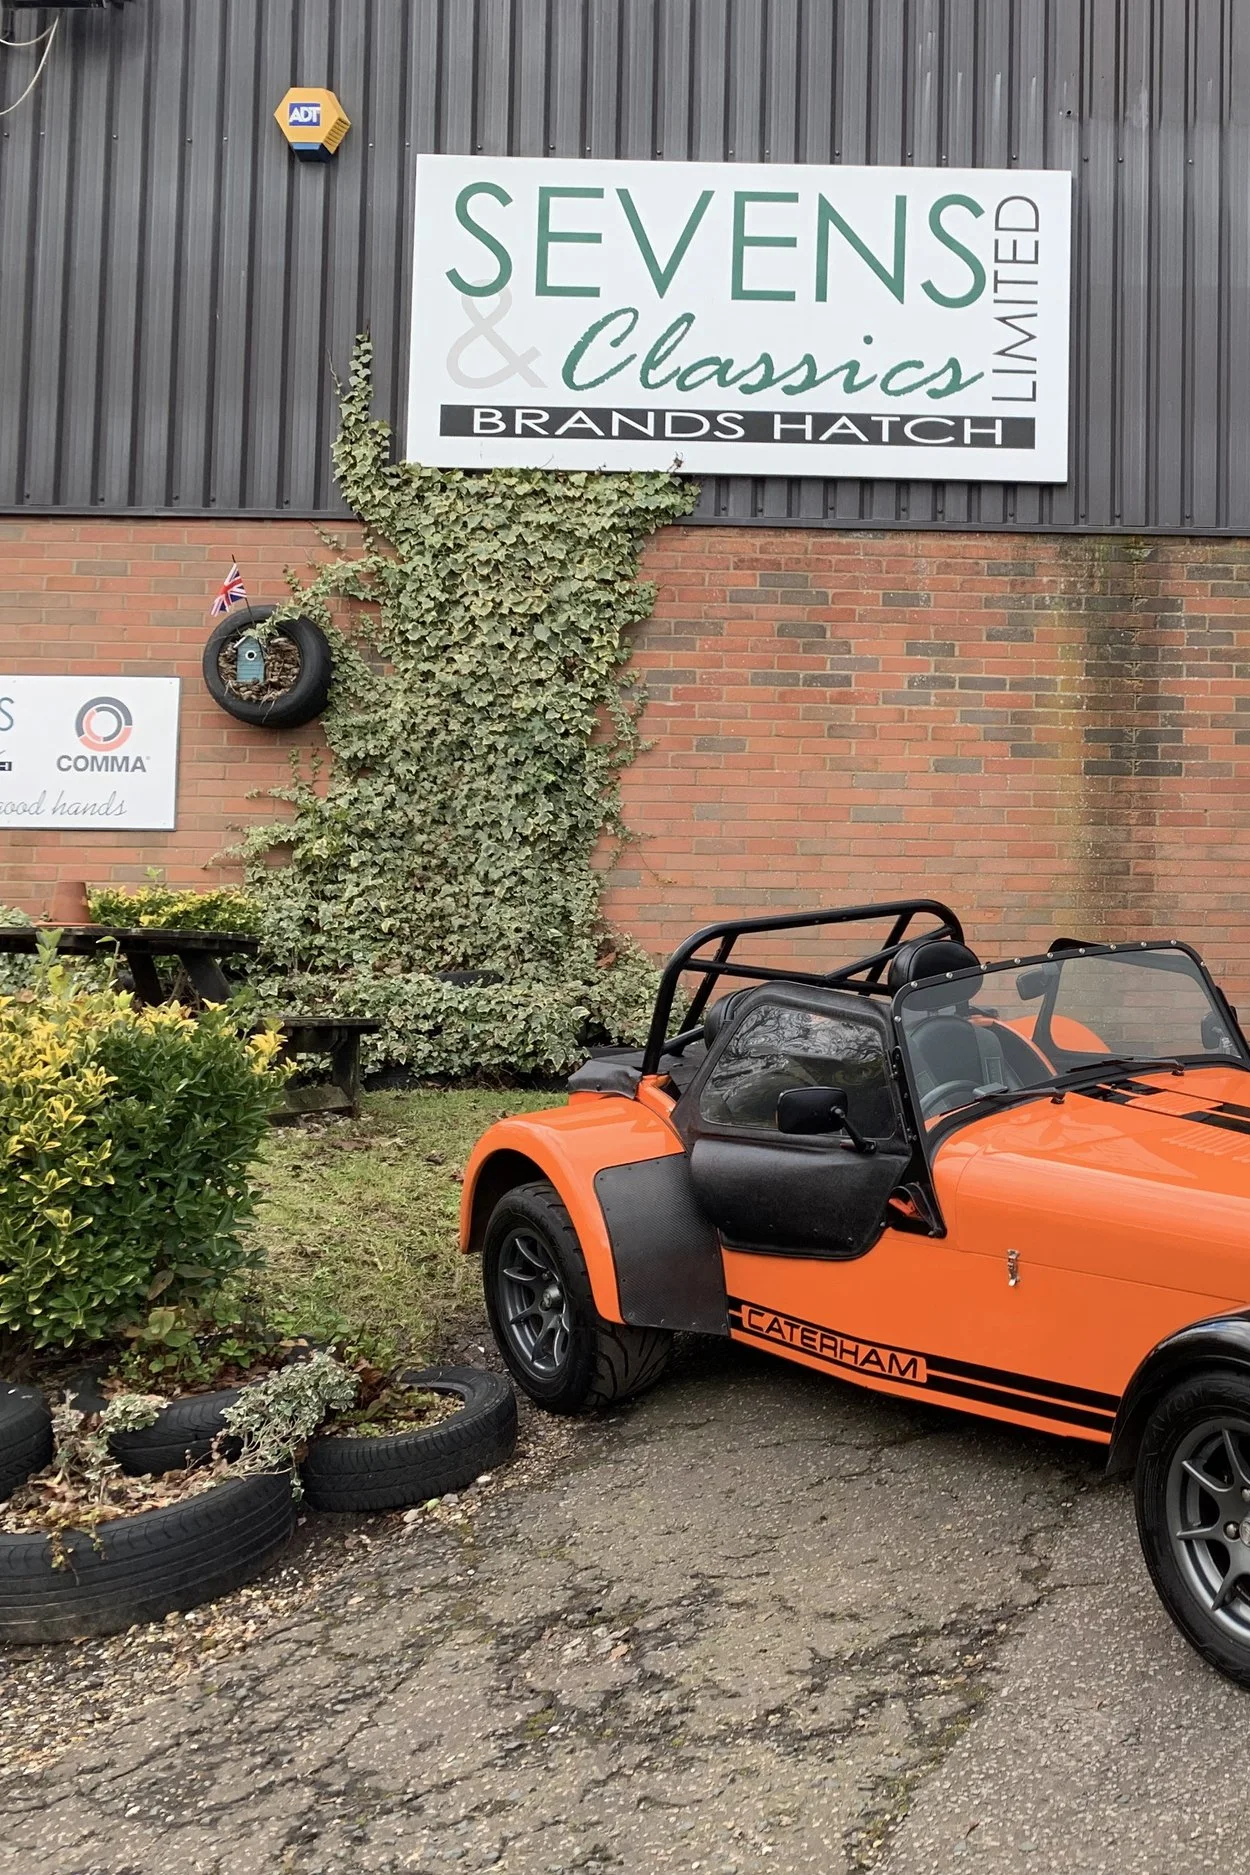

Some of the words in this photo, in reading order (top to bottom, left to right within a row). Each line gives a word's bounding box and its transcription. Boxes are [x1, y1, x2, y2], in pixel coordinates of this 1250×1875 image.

[289, 107, 321, 123] ADT
[445, 181, 987, 309] SEVENS
[991, 195, 1040, 402] LIMITED
[446, 279, 548, 390] &
[561, 306, 985, 399] Classics
[472, 407, 745, 440] BRANDS
[772, 413, 1003, 446] HATCH
[56, 754, 147, 773] COMMA
[52, 789, 127, 816] hands
[747, 1308, 919, 1380] CATERHAM
